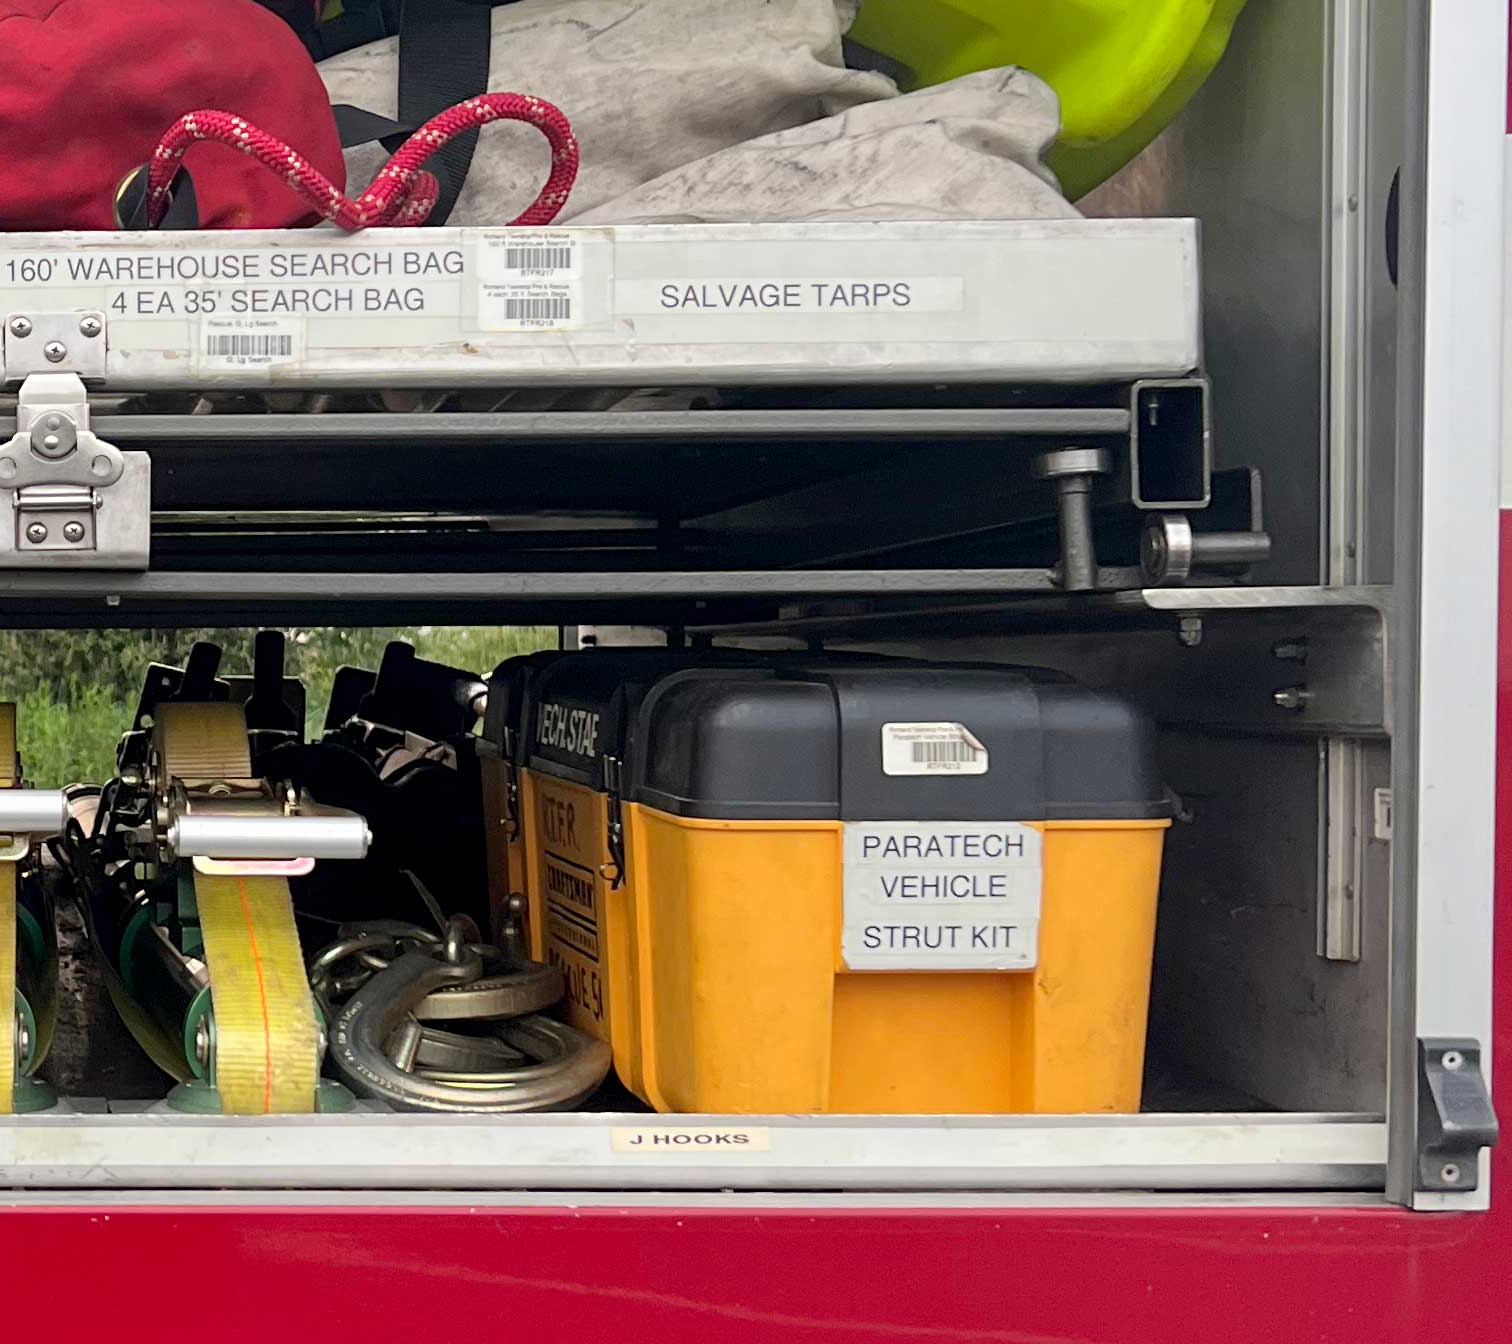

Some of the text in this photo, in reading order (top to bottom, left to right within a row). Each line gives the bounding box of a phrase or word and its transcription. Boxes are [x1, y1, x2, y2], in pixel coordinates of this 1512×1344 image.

[6, 250, 466, 282] 160' WAREHOUSE SEARCH BAG
[112, 286, 426, 315] 4 EA 35' SEARCH BAG
[660, 282, 913, 309] SALVAGE TARPS
[861, 833, 1025, 859] PARATECH
[879, 874, 1008, 899] VEHICLE
[862, 924, 1018, 950] STRUT KIT
[629, 1133, 751, 1145] J HOOKS
